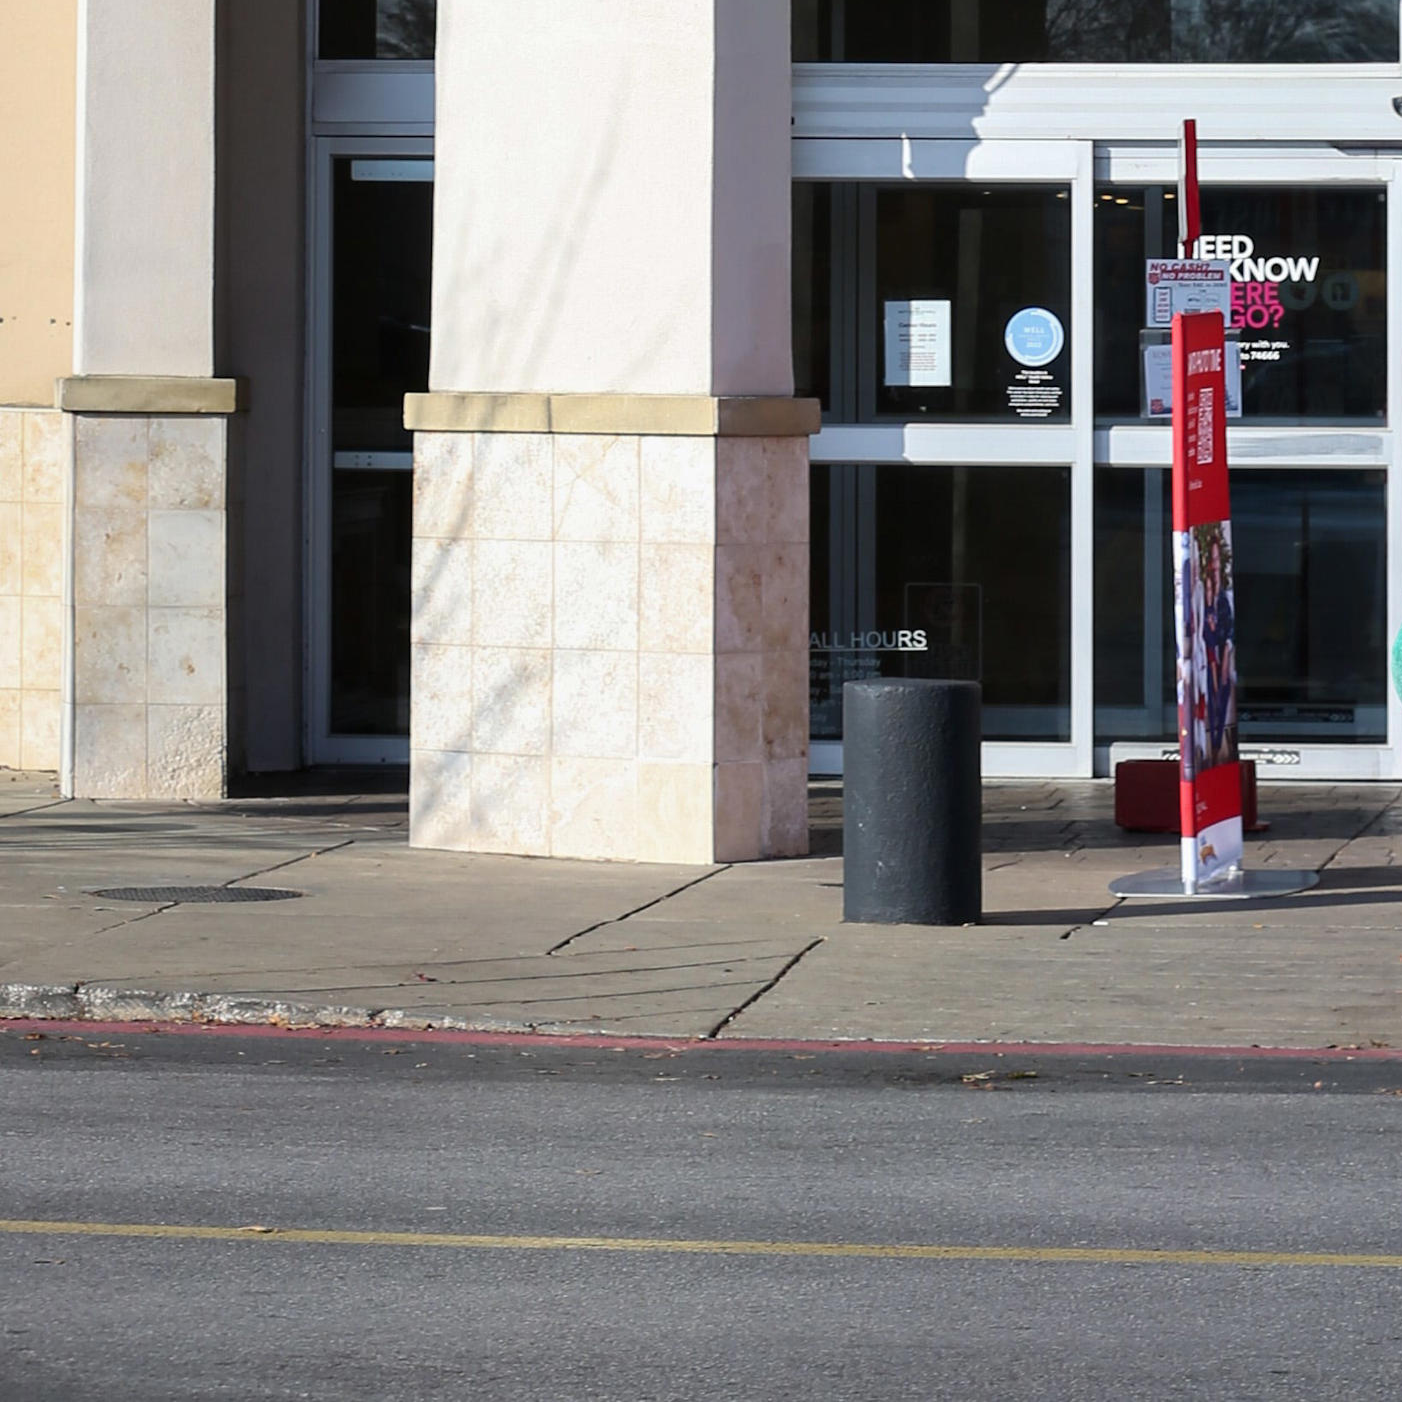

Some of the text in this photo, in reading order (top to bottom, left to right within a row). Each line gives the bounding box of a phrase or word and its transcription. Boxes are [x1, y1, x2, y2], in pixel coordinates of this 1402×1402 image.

[1229, 257, 1320, 282] KNOW
[1231, 282, 1280, 305] ERE
[809, 629, 928, 650] ALL HOURS
